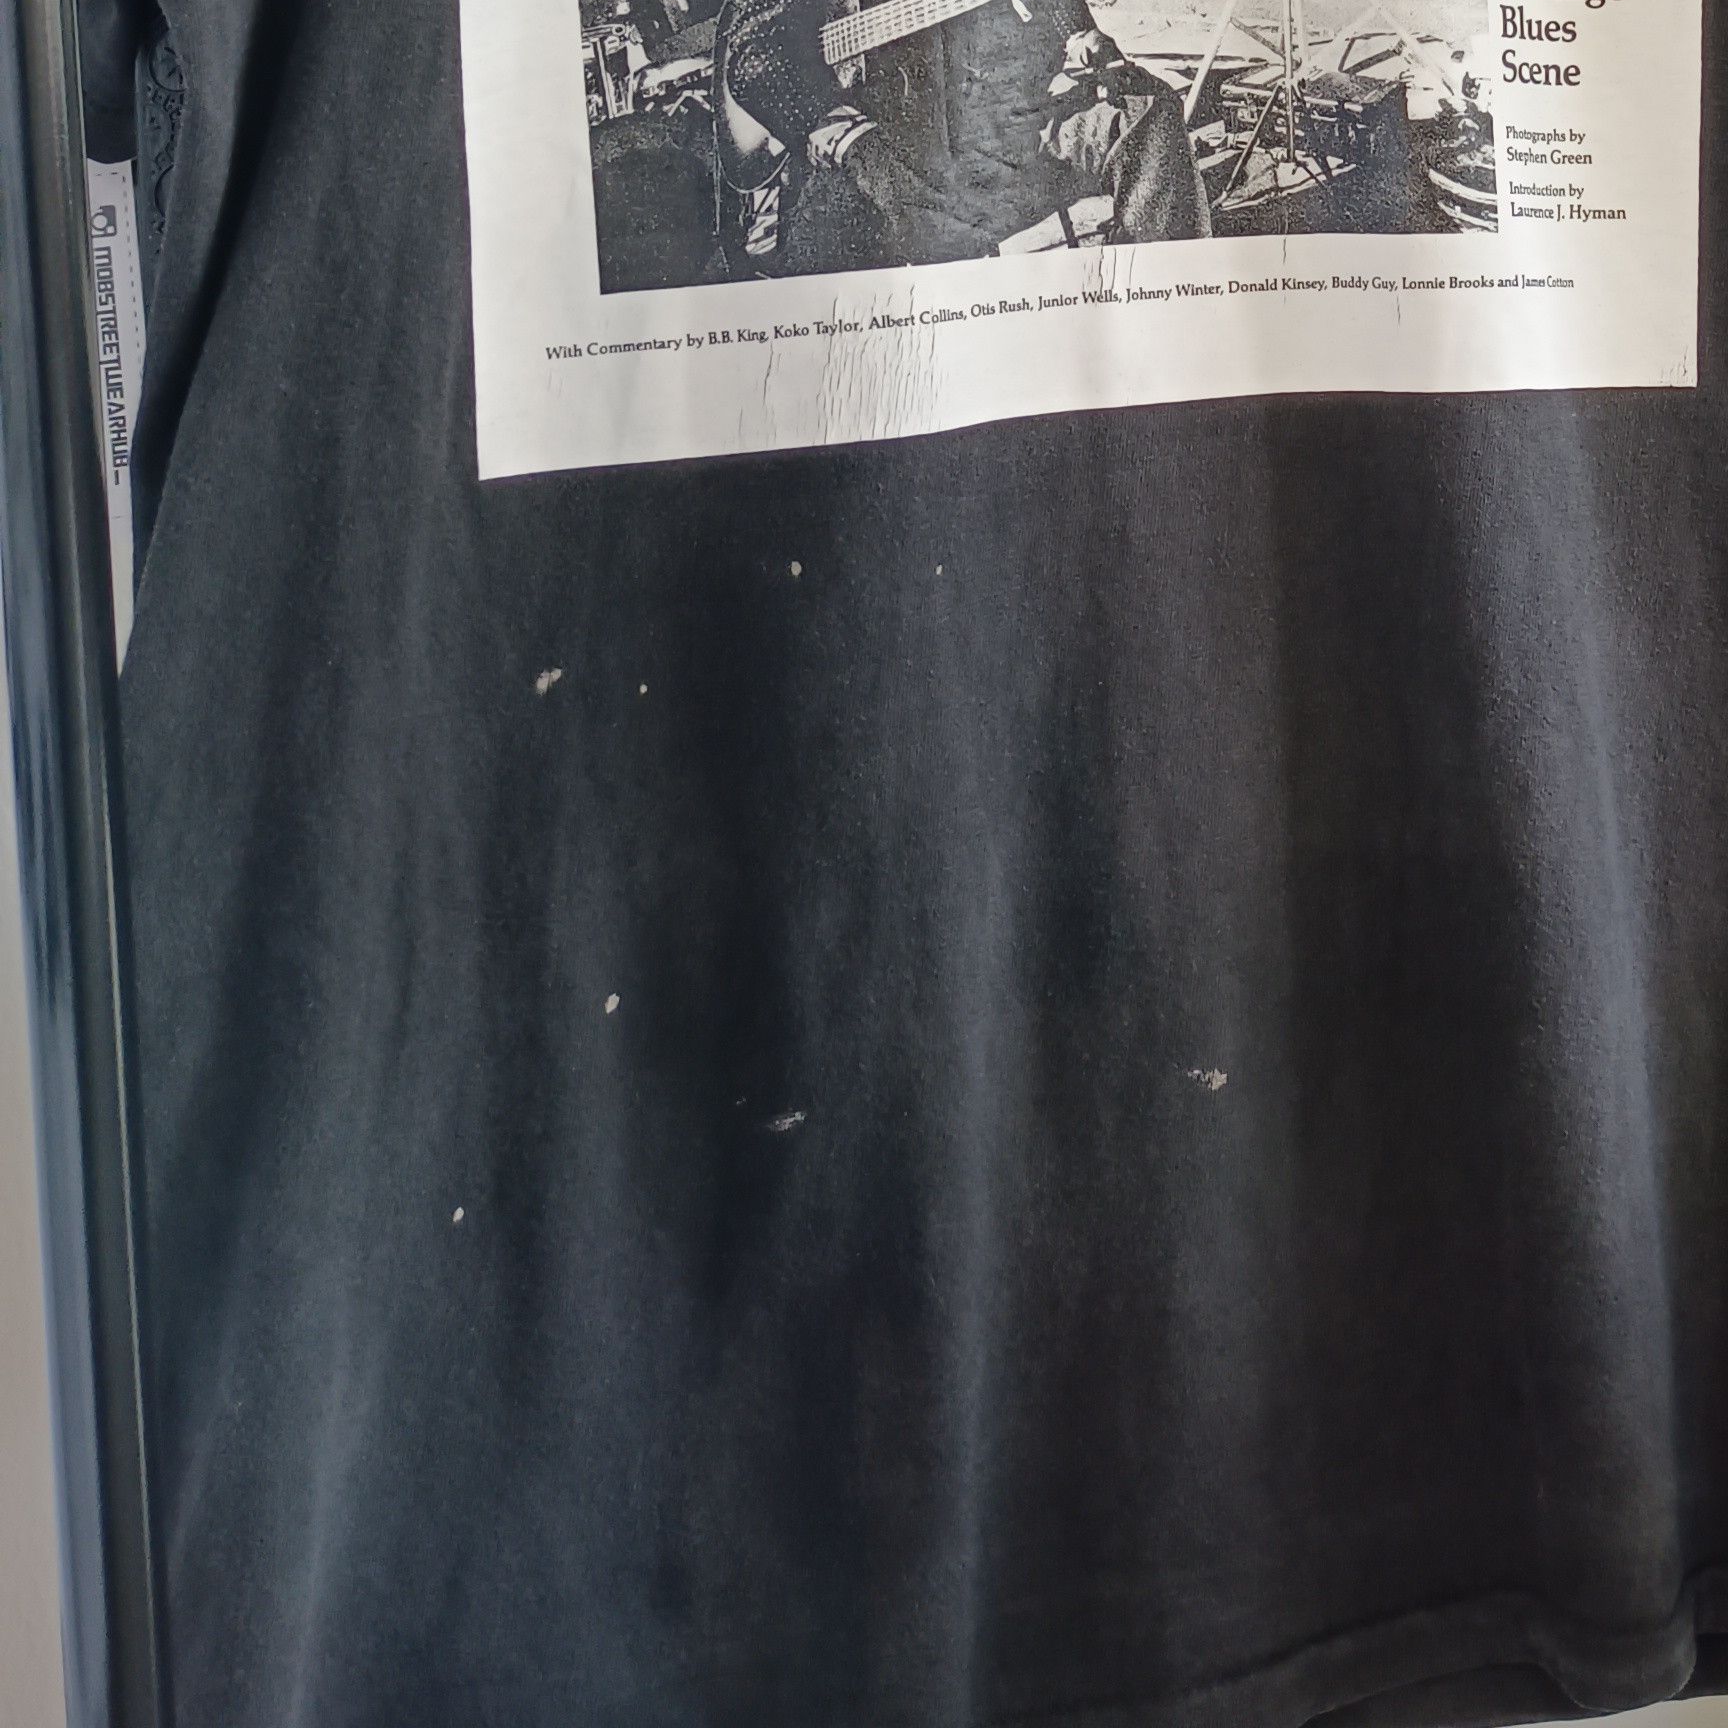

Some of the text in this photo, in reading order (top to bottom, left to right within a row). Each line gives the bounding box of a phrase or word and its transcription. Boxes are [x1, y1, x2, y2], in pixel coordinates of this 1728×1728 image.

[1500, 4, 1577, 43] Blues
[1502, 50, 1581, 86] Scene
[1506, 125, 1586, 144] Photographs by
[1507, 147, 1593, 166] Stephen Green
[1509, 181, 1585, 199] Introduction by
[1511, 202, 1627, 222] Laurence J. Hyman
[545, 344, 584, 361] With
[586, 335, 684, 356] Commentary
[686, 334, 704, 350] by
[708, 327, 734, 345] B.B.
[773, 323, 810, 339] Koko
[813, 318, 864, 336] Taylor,
[869, 311, 916, 330] Albert
[919, 305, 966, 325] Collins,
[970, 302, 996, 317] Otis
[999, 298, 1034, 315] Rush,
[1037, 292, 1079, 309] Junior
[1082, 287, 1122, 306] Wells,
[1126, 285, 1172, 304] Johnny
[1175, 282, 1225, 297] Winter,
[1228, 278, 1278, 294] Donald
[1282, 276, 1328, 291] Kinsey,
[1332, 275, 1369, 291] Buddy
[1372, 276, 1399, 290] Guy,
[1402, 275, 1446, 290] Lonnie
[1449, 274, 1495, 289] Brooks
[1497, 274, 1519, 288] and
[1521, 273, 1546, 288] James
[1547, 275, 1575, 288] Cotton
